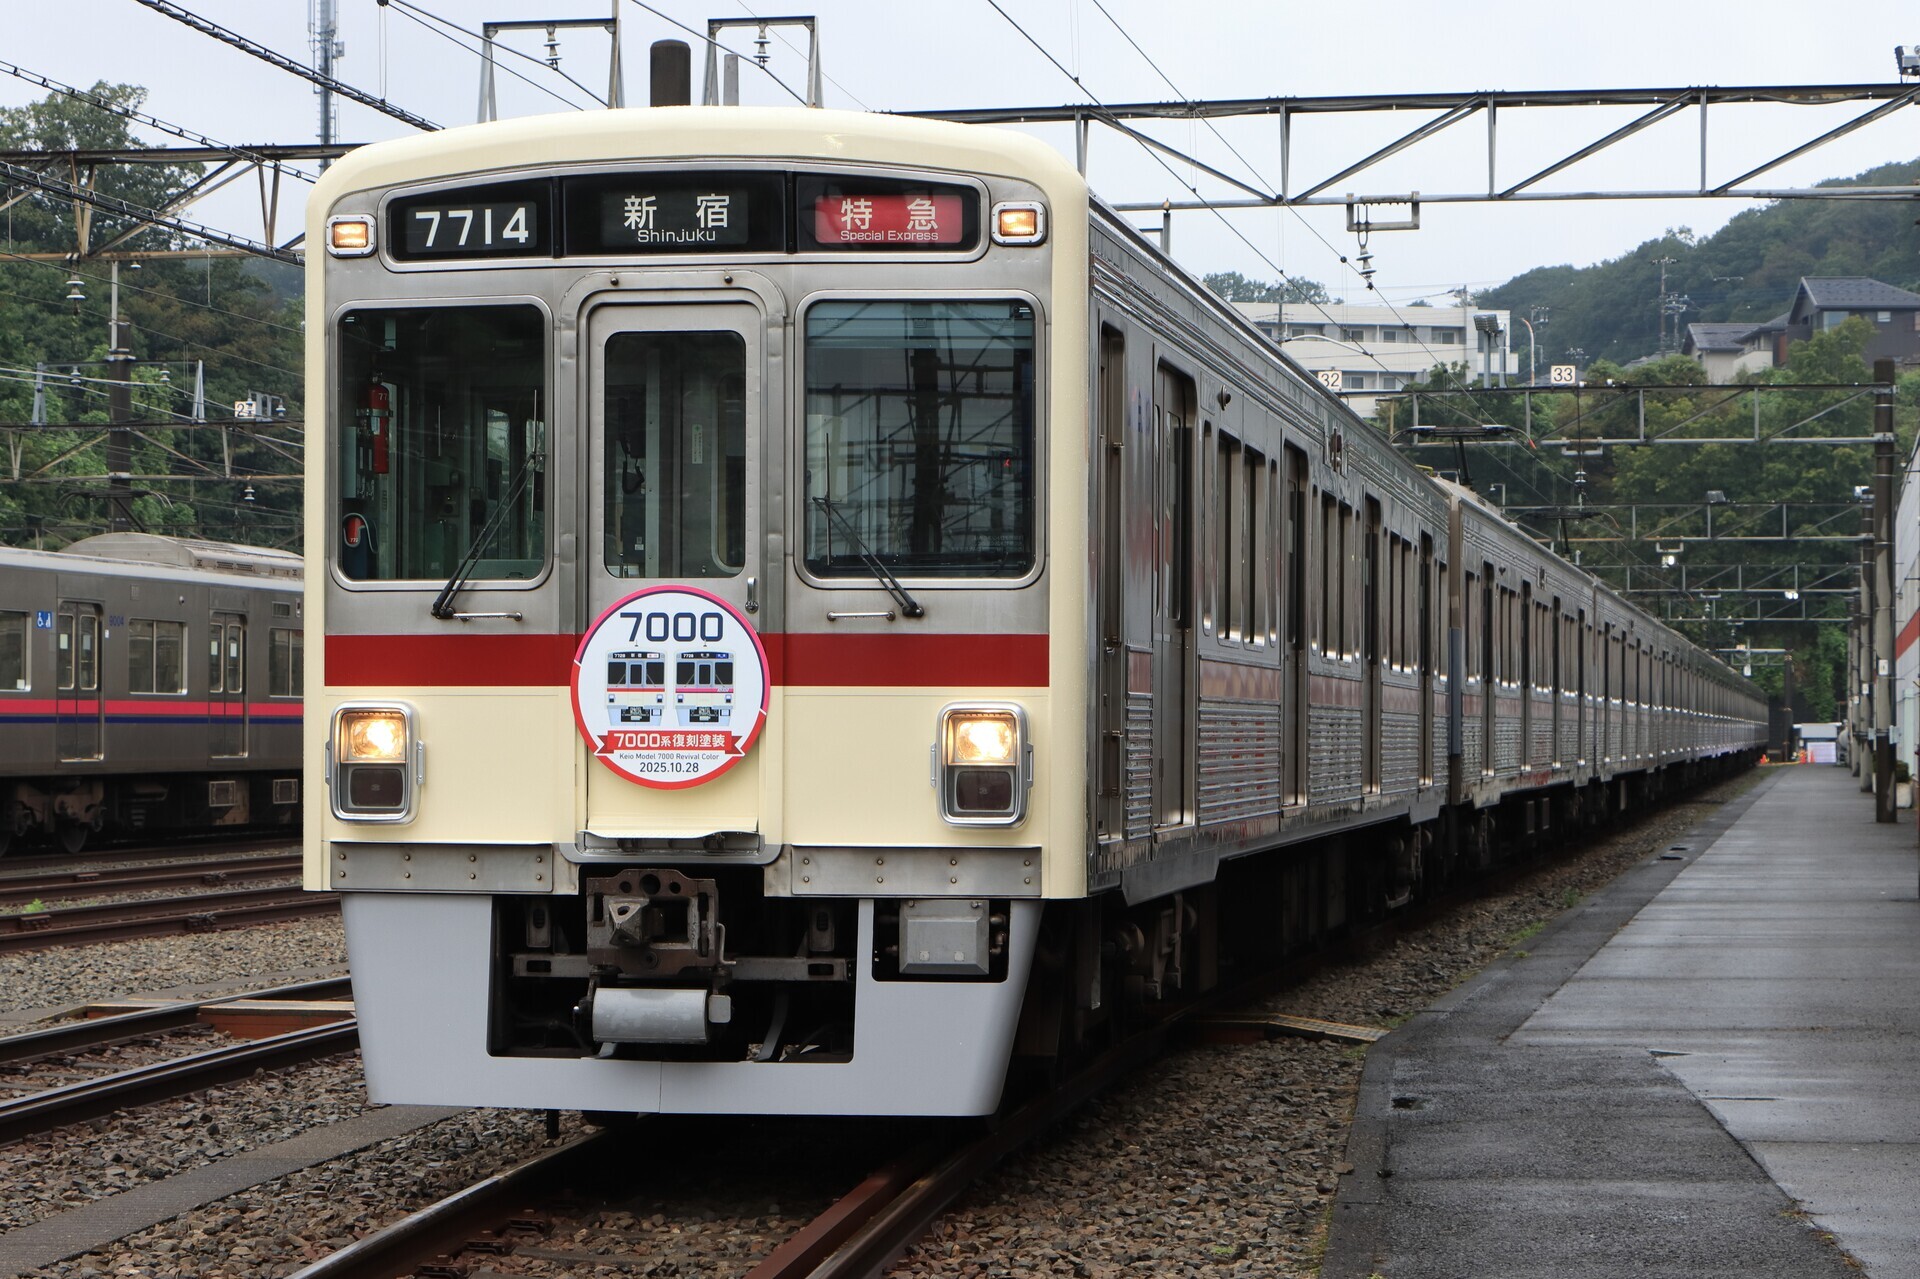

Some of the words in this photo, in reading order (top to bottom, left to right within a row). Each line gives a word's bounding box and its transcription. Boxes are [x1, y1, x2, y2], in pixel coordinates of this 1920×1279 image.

[623, 193, 730, 230] 新宿
[840, 198, 939, 231] 特急
[414, 206, 530, 248] 7714
[637, 229, 716, 243] Shinjuku
[840, 230, 885, 241] Special
[887, 230, 939, 241] Express
[1321, 372, 1340, 387] 32
[1553, 367, 1573, 382] 33
[619, 612, 724, 642] 7000
[613, 733, 726, 748] 7000系復刻塗装
[639, 762, 700, 773] 2025.10.28
